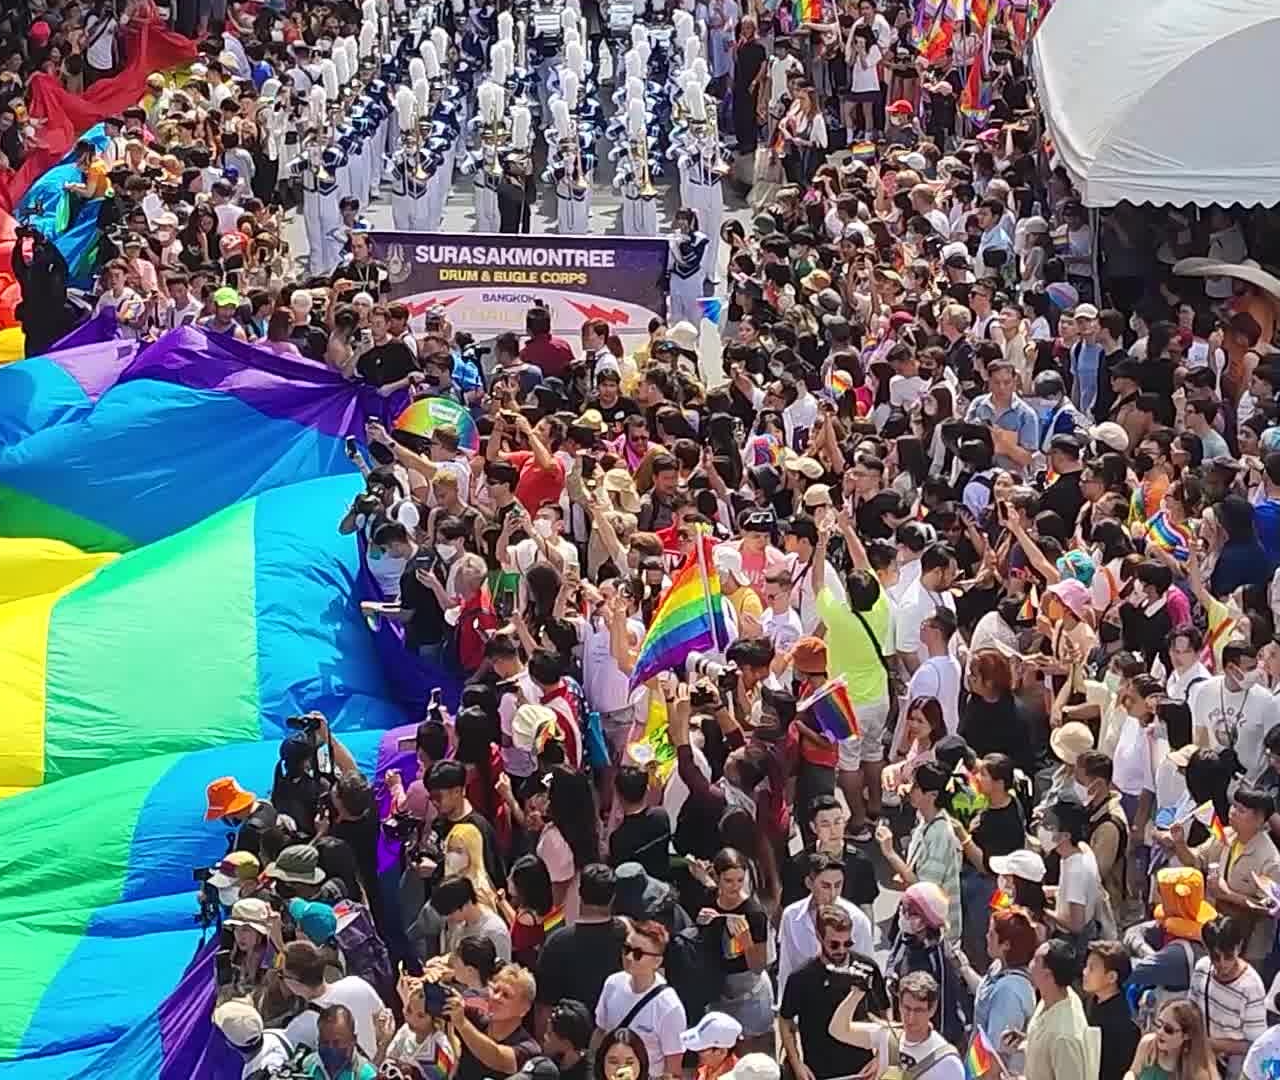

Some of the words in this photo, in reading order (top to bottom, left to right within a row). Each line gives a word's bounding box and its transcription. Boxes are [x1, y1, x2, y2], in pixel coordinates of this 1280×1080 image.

[415, 245, 616, 268] SURASAKMONTREE
[439, 269, 479, 281] DRUM
[481, 270, 491, 282] &
[493, 271, 539, 284] BUGLE
[540, 271, 587, 285] CORPS
[481, 293, 536, 304] BANGKOK
